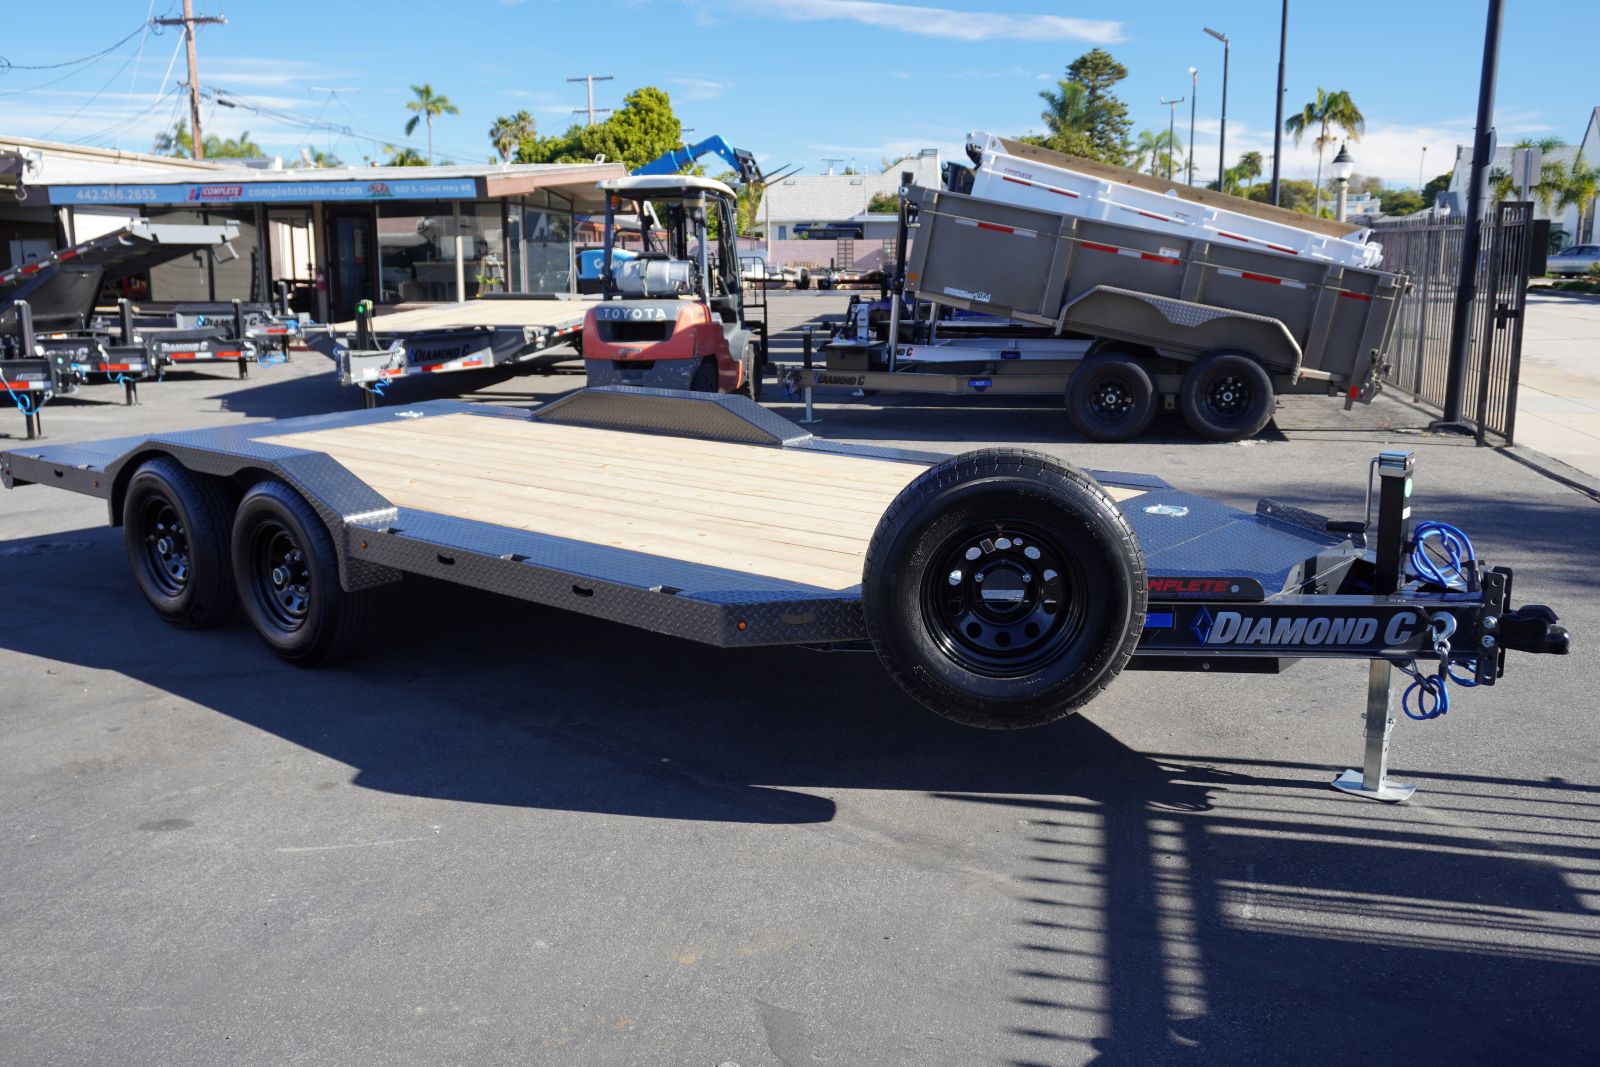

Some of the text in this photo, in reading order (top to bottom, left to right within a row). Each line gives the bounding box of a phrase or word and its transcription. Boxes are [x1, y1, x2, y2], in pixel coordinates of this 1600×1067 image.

[203, 186, 239, 196] COMPLETE
[248, 185, 364, 198] completetrailers.com
[603, 308, 667, 319] TOYOTA
[161, 342, 209, 352] DIAMOND C
[415, 344, 470, 361] DIAMOND C
[906, 347, 914, 357] C
[818, 374, 866, 386] DIAMOND C
[1147, 580, 1231, 592] MPLETE
[1207, 611, 1418, 646] DIAMOND C
